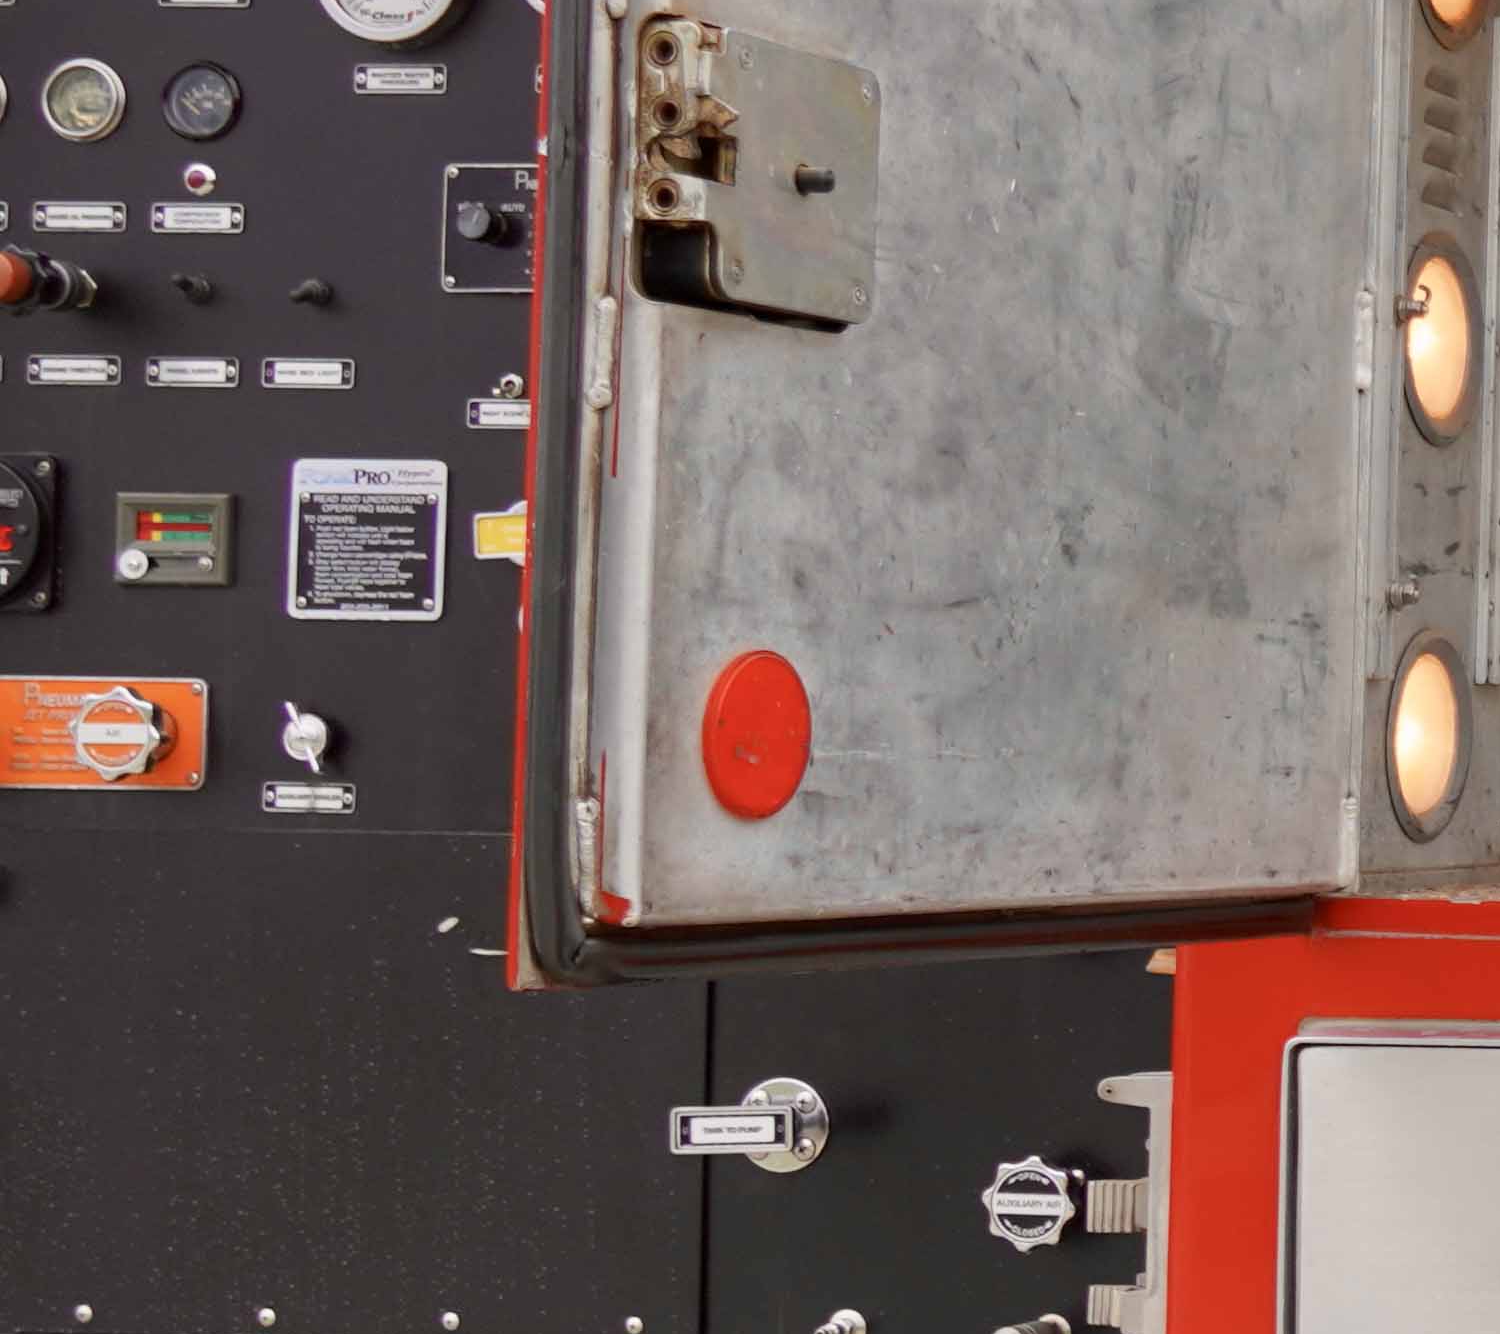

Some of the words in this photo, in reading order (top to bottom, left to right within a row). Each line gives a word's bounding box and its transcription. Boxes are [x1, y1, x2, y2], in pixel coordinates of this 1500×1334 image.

[341, 495, 361, 503] AND
[1012, 1172, 1043, 1182] OPEN
[997, 1198, 1043, 1208] AUXILIARY
[1011, 1225, 1046, 1237] CLOSED
